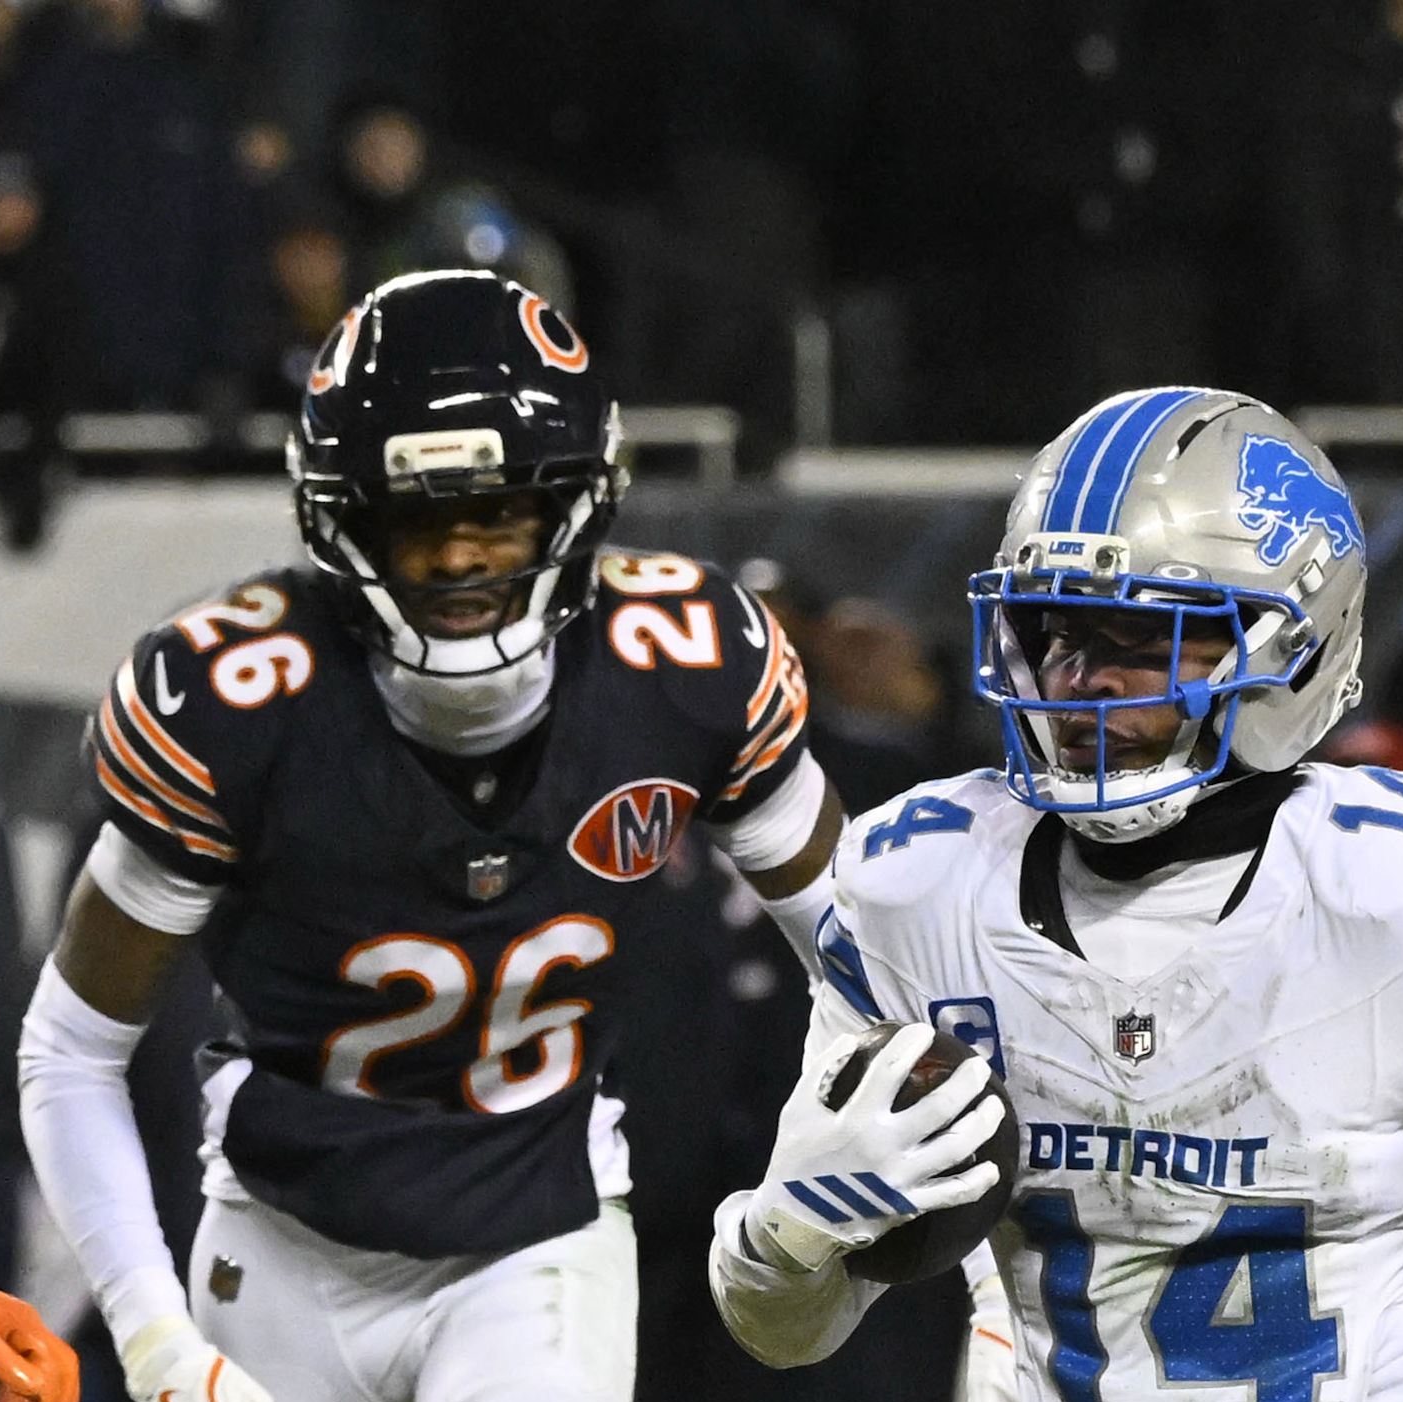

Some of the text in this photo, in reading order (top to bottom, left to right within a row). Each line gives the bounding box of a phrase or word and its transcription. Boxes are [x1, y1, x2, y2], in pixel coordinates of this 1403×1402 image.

[176, 584, 314, 709] 26
[599, 549, 723, 671] 26
[322, 912, 615, 1115] 26
[1120, 1034, 1151, 1054] NFL
[1026, 1121, 1269, 1188] DETROIT
